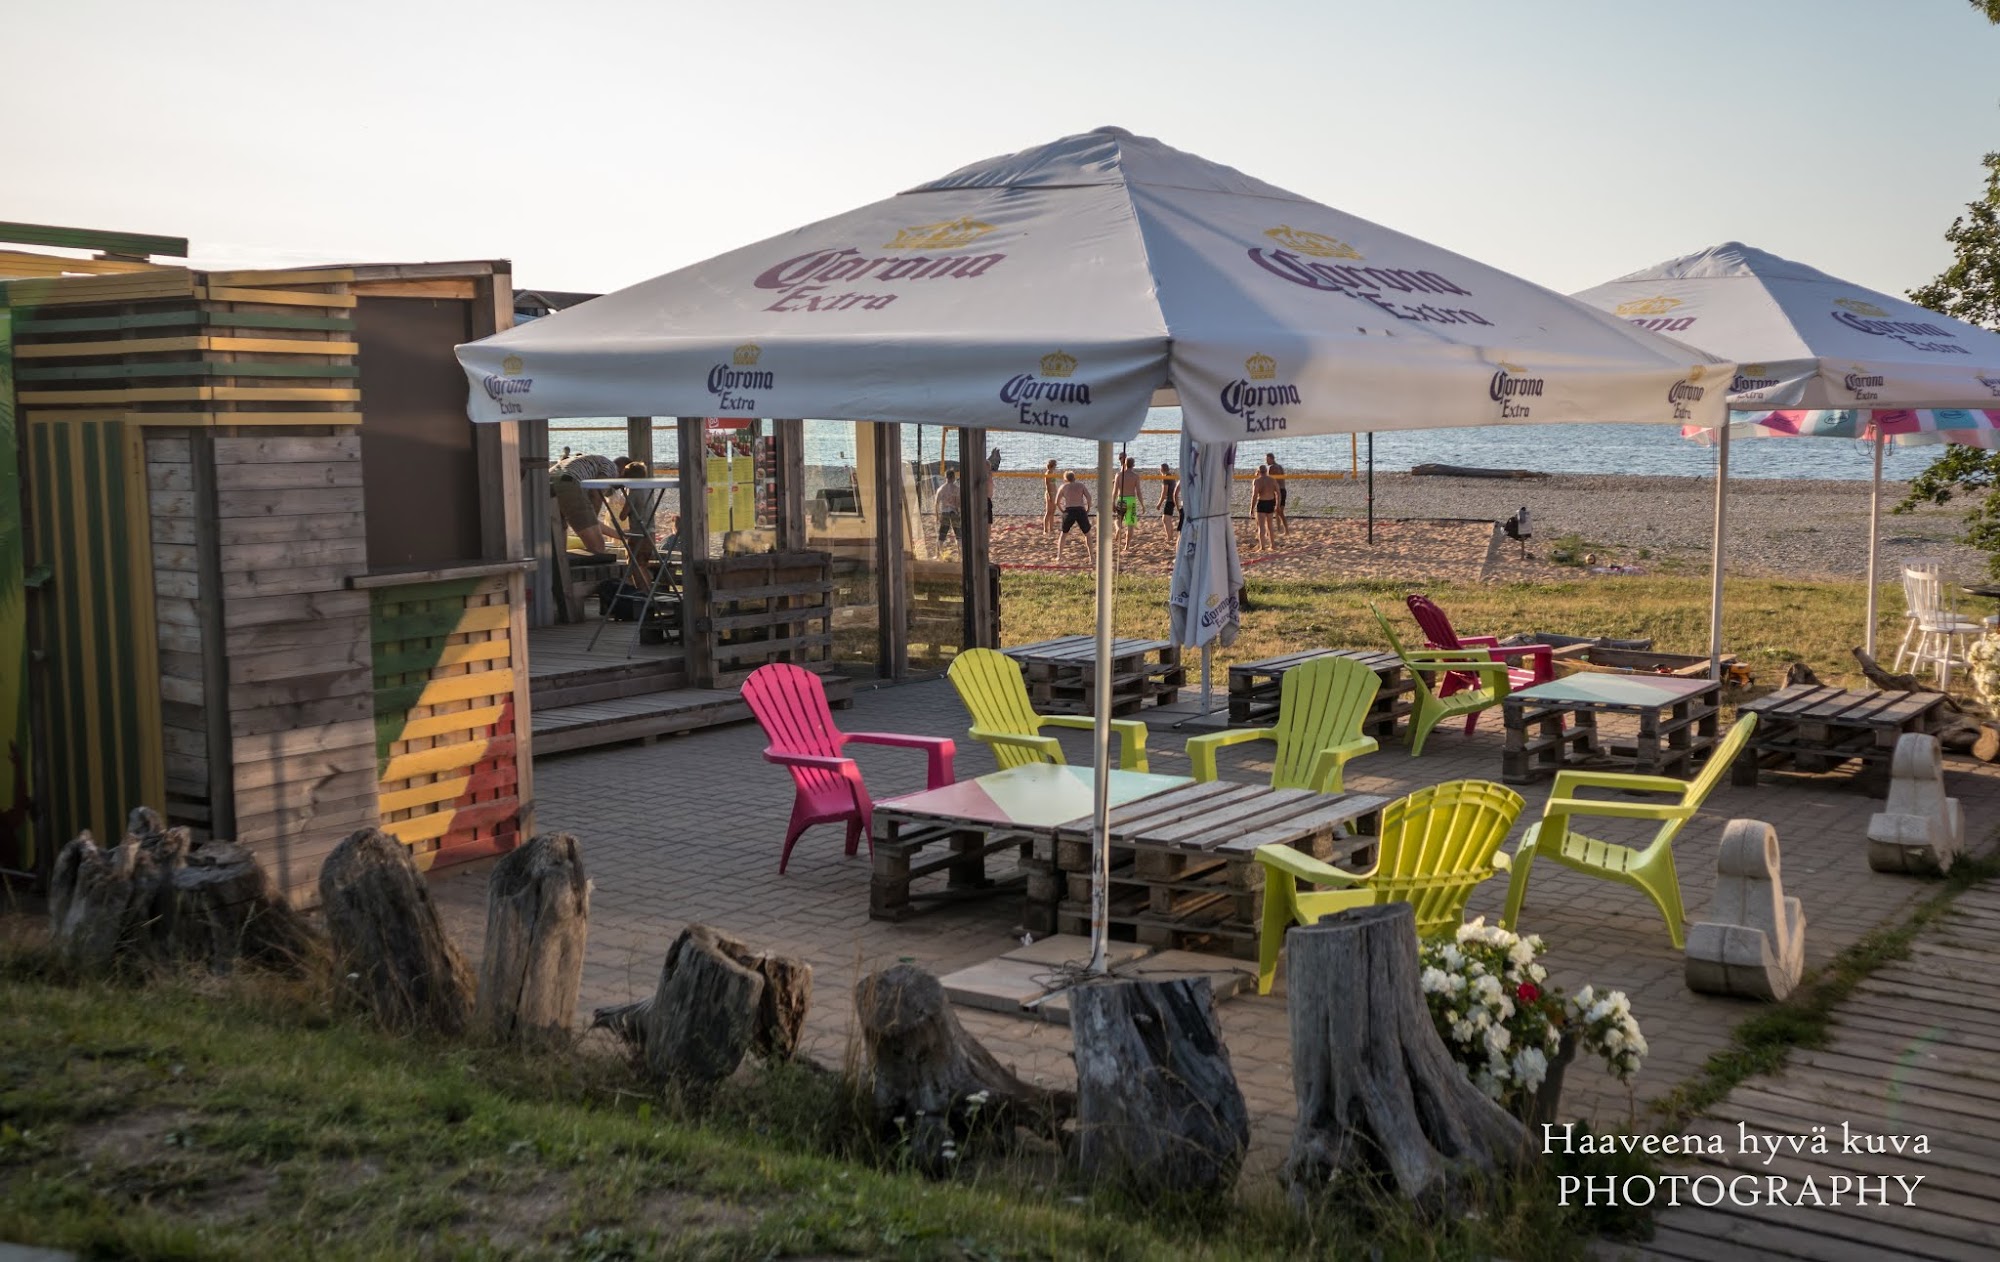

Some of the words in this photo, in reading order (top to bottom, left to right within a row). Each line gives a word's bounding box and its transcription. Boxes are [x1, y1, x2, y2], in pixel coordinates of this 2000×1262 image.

[754, 247, 1008, 294] Corona
[1247, 247, 1472, 298] Corona
[761, 285, 898, 312] Extra
[1356, 291, 1495, 326] Extra
[483, 374, 533, 400] Corona
[707, 363, 774, 397] Corona
[999, 373, 1092, 408] Corona
[1490, 370, 1544, 405] Corona
[1668, 379, 1705, 406] Corona
[1844, 373, 1884, 392] Corona
[500, 399, 523, 415] Extra
[719, 391, 756, 410] Extra
[1220, 378, 1302, 418] Corona
[1501, 398, 1530, 418] Extra
[1018, 402, 1069, 428] Extra
[1245, 409, 1287, 433] Extra
